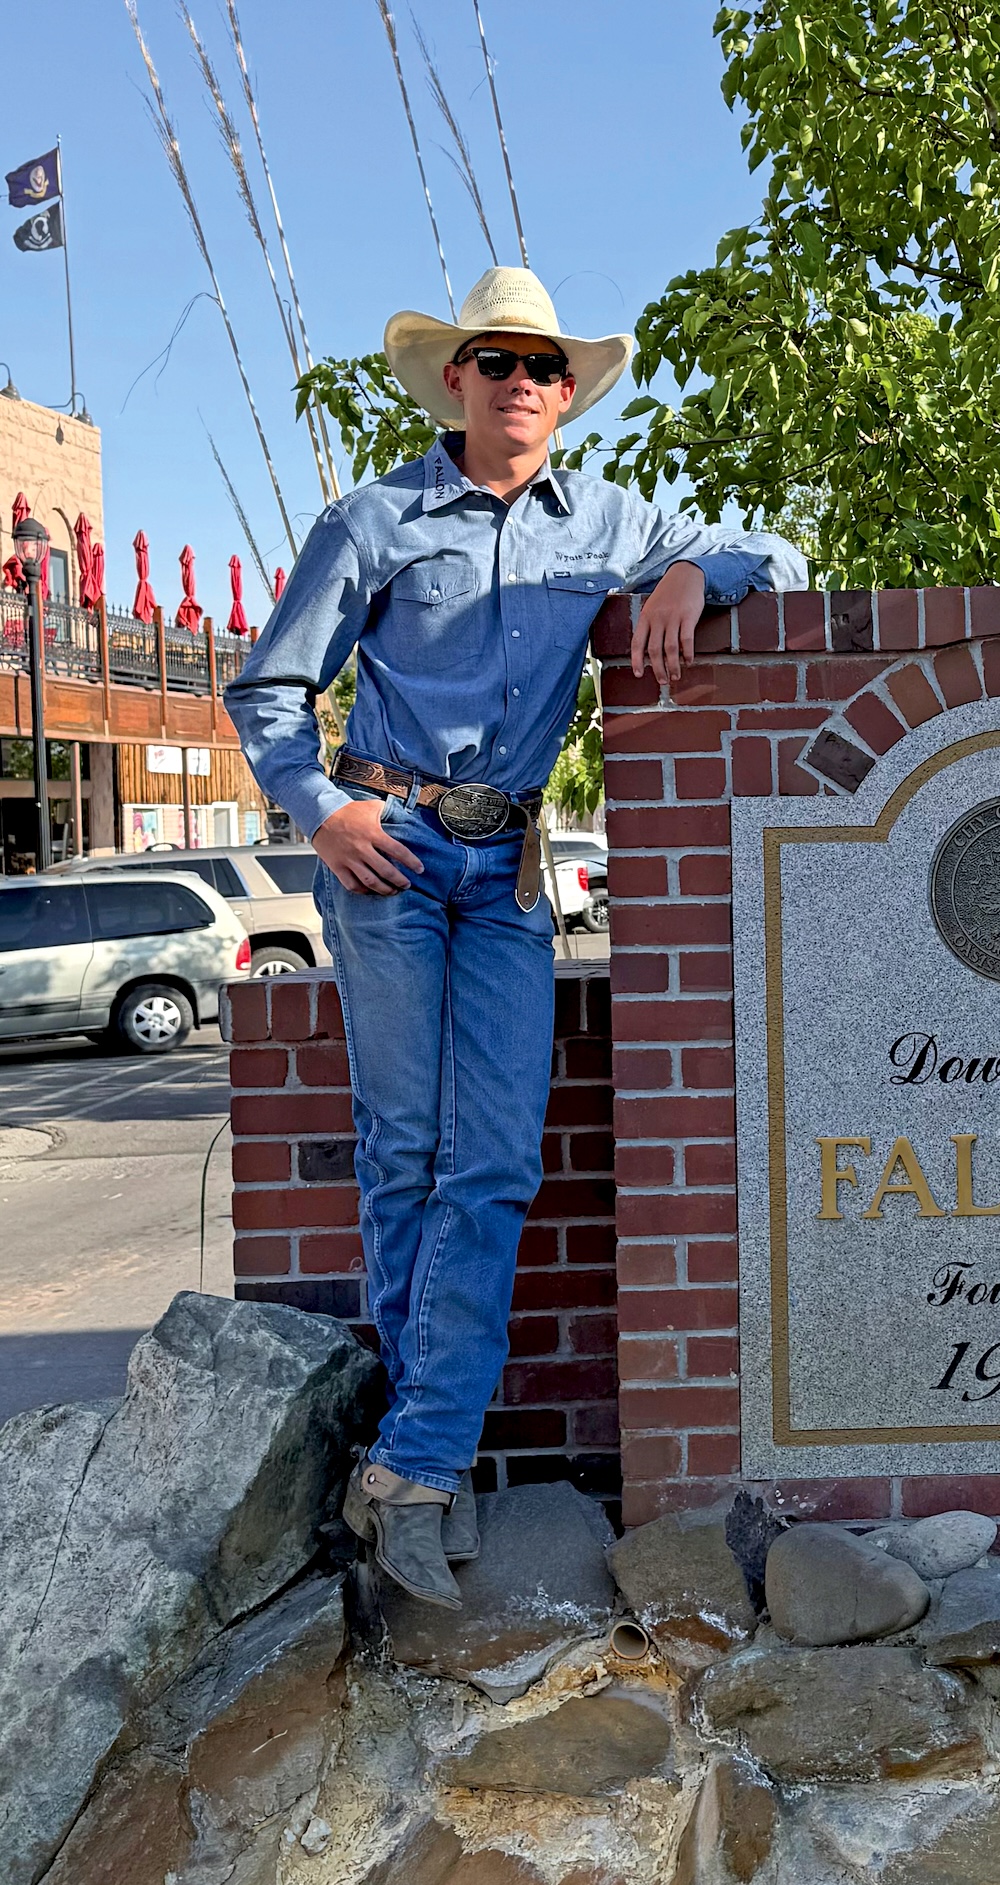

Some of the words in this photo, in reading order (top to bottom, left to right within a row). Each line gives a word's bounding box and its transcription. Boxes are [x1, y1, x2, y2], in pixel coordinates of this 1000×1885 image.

[434, 456, 445, 499] FALLON
[953, 814, 988, 847] CITY
[954, 934, 997, 974] OASIS
